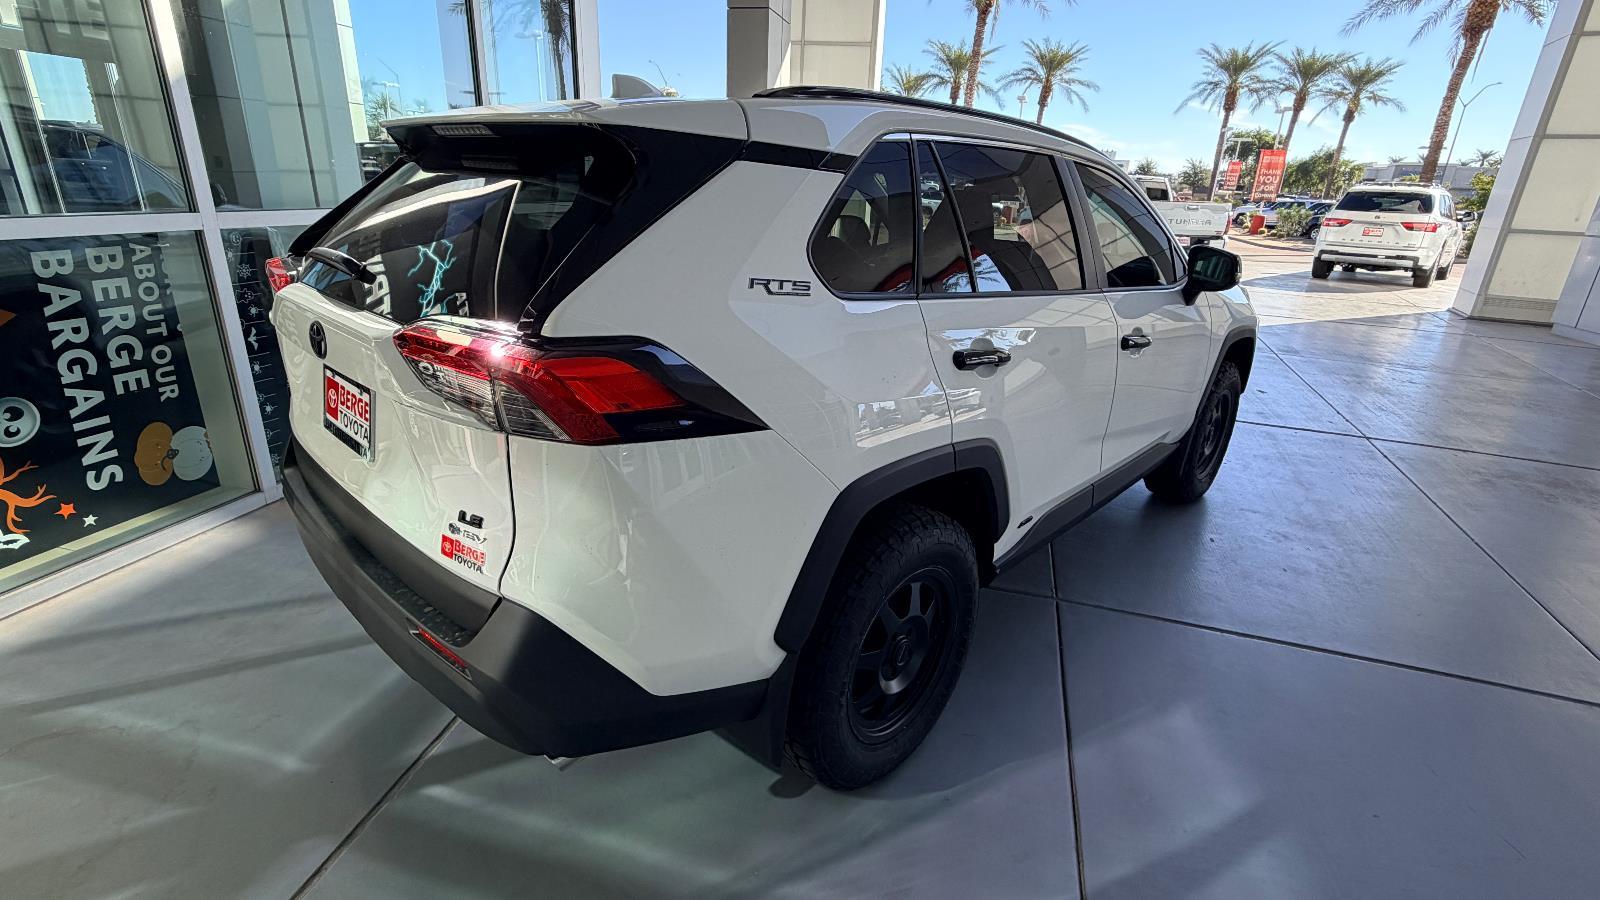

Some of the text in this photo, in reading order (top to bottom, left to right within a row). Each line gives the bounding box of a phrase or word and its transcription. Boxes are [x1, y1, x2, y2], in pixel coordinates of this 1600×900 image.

[1259, 175, 1280, 184] YOU
[748, 278, 811, 296] RTS
[86, 246, 150, 395] BERGE
[129, 243, 179, 402] ABOUT OUR
[30, 249, 124, 491] BARGAINS
[339, 384, 369, 423] BERGE
[339, 410, 370, 443] TOYOTA
[454, 539, 485, 566] BERGE
[454, 553, 484, 574] TOYOTA
